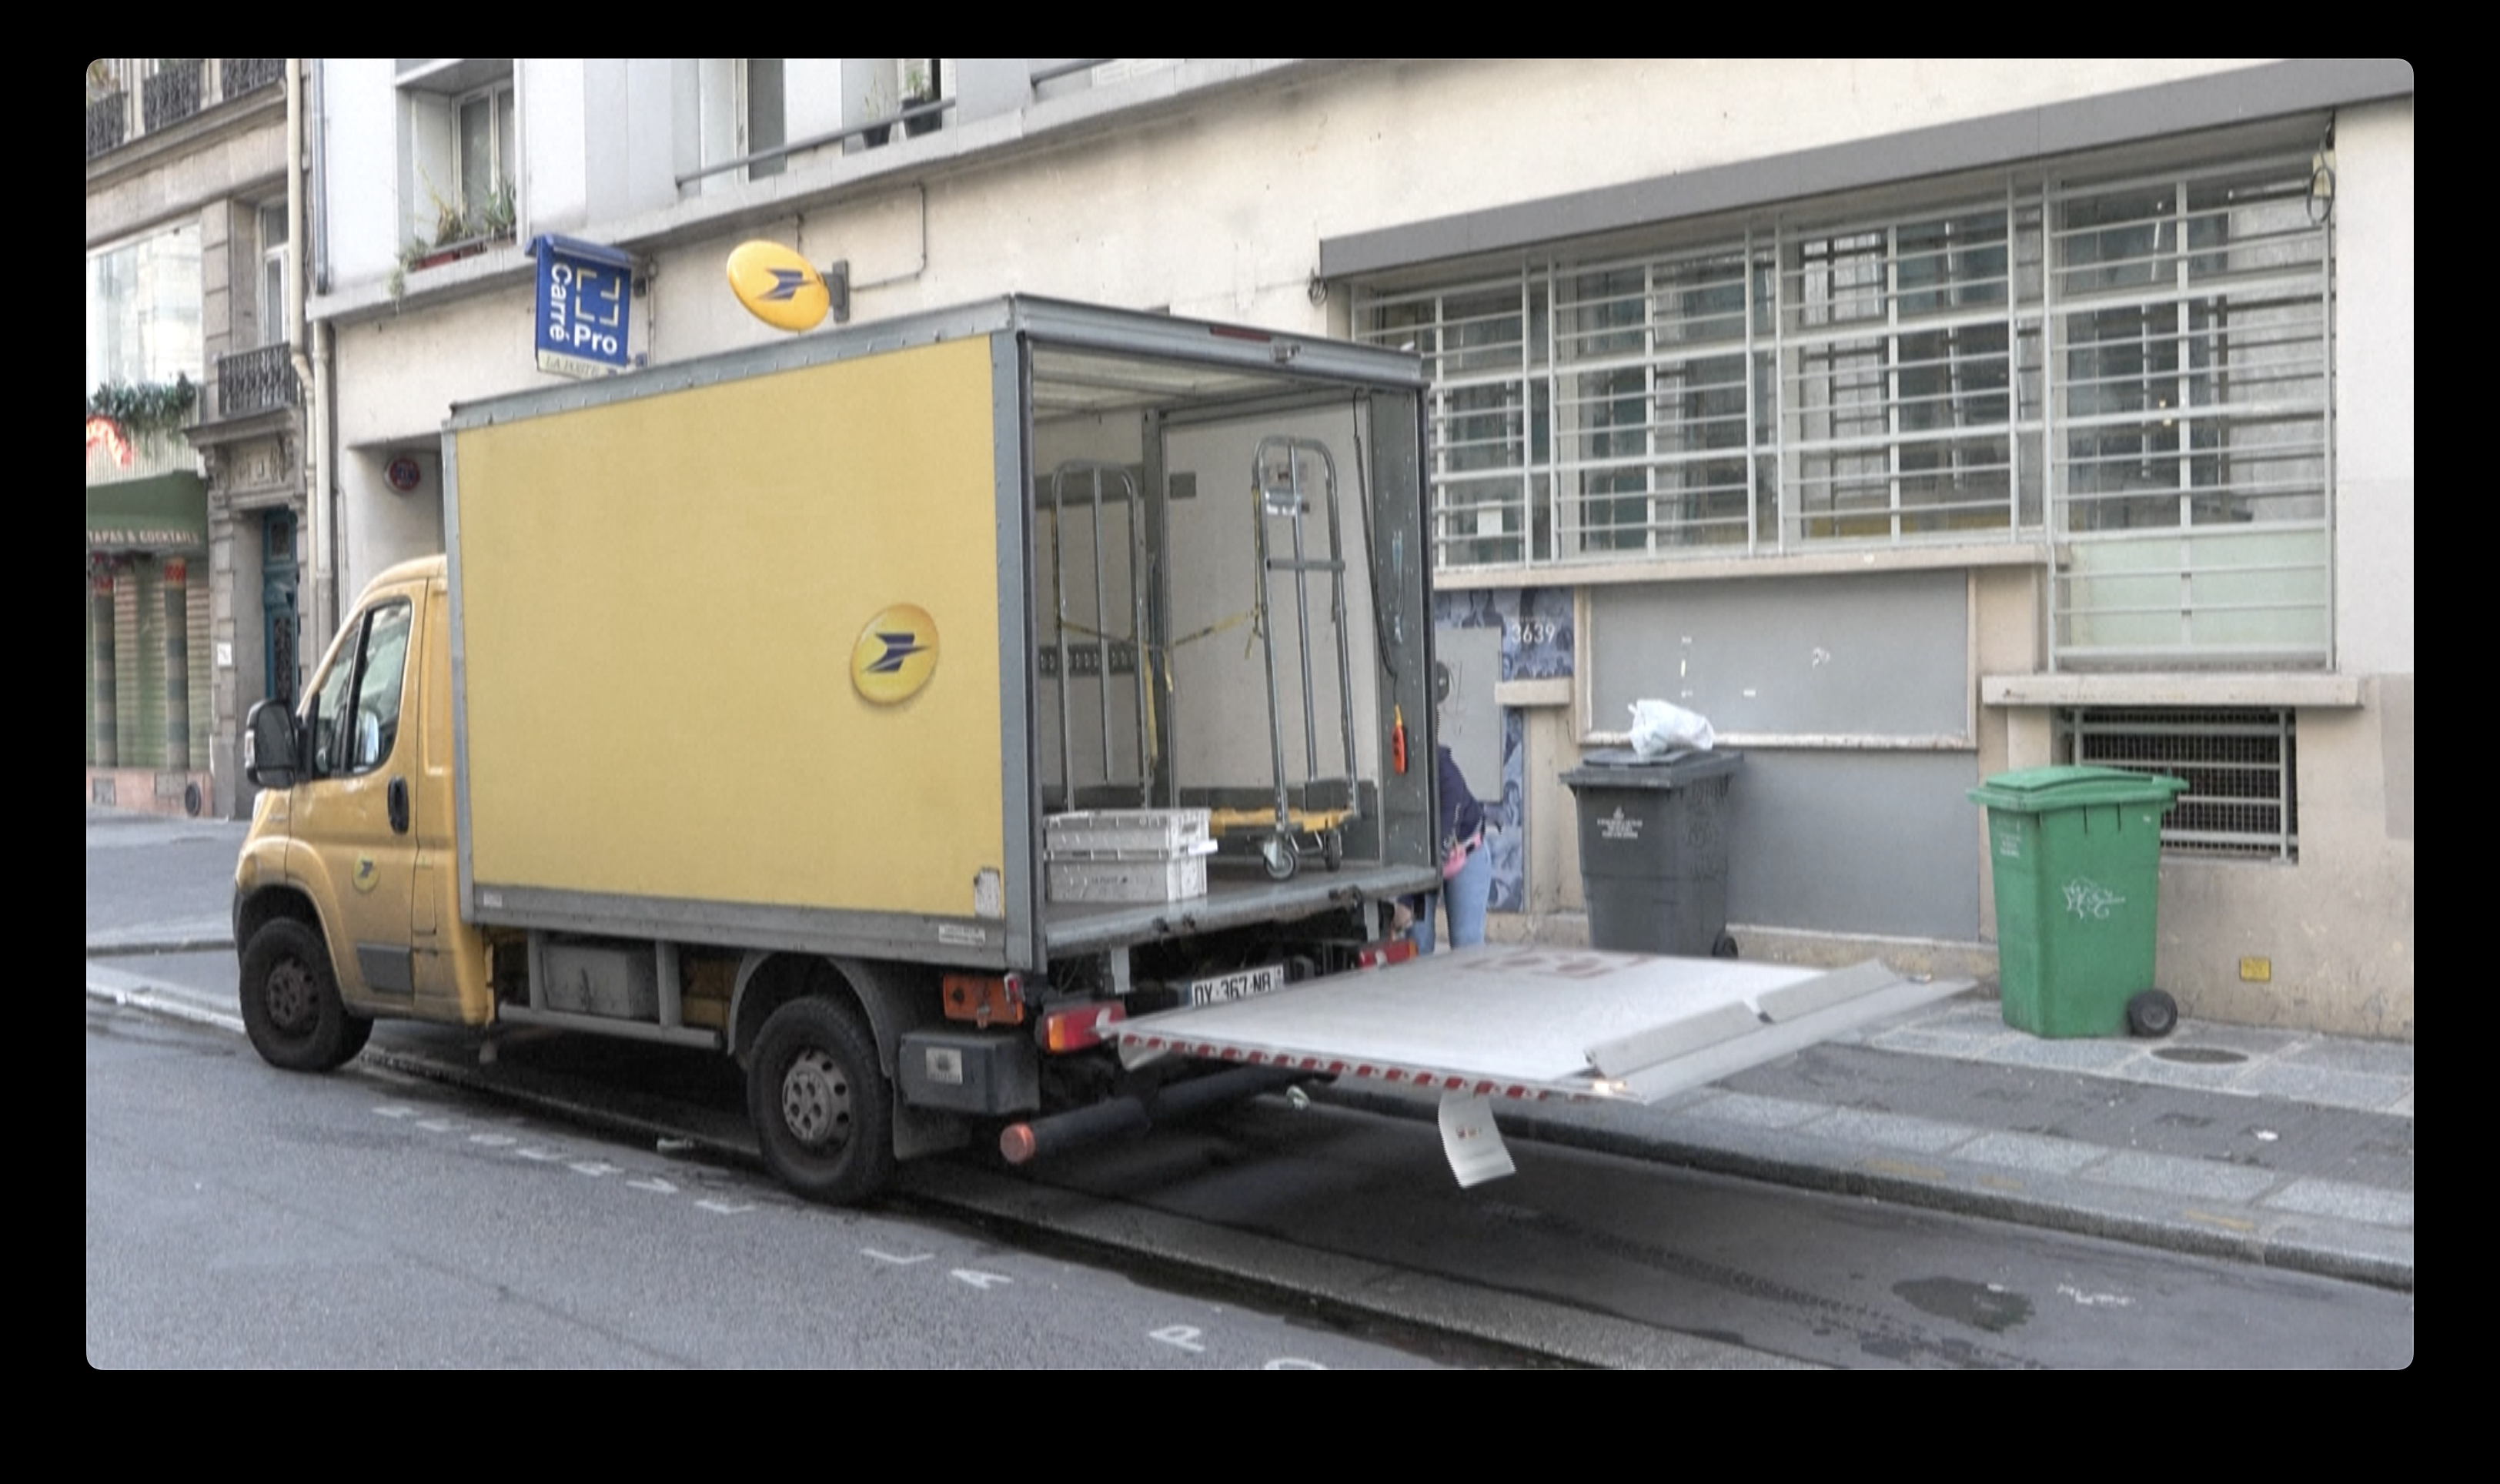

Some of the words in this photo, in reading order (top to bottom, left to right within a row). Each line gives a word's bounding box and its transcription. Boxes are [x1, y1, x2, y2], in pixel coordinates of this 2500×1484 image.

[549, 263, 572, 342] Carré
[574, 323, 617, 355] Pro
[1511, 623, 1556, 644] 3639
